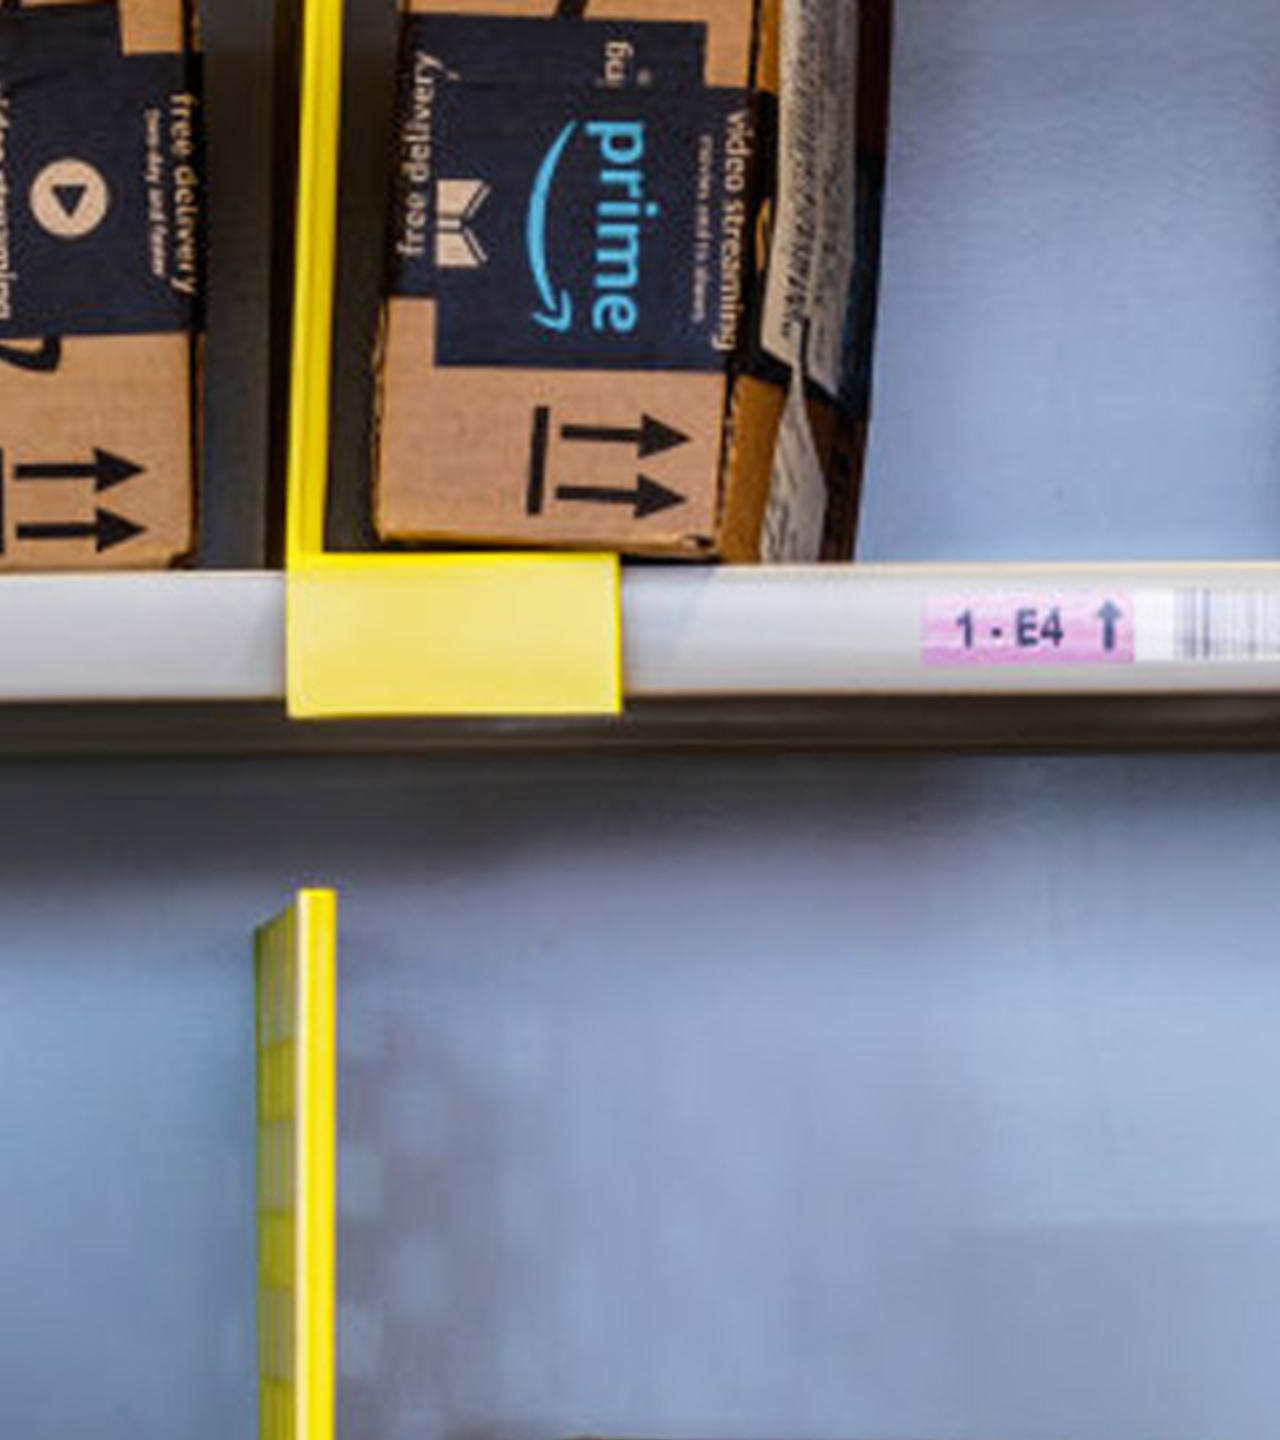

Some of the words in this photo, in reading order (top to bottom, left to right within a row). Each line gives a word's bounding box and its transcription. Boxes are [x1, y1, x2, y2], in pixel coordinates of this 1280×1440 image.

[171, 92, 196, 156] free
[403, 51, 460, 182] delivery
[725, 111, 753, 191] video
[172, 166, 198, 294] delivery
[397, 192, 425, 257] free
[585, 120, 659, 333] prime
[713, 200, 748, 351] streaming
